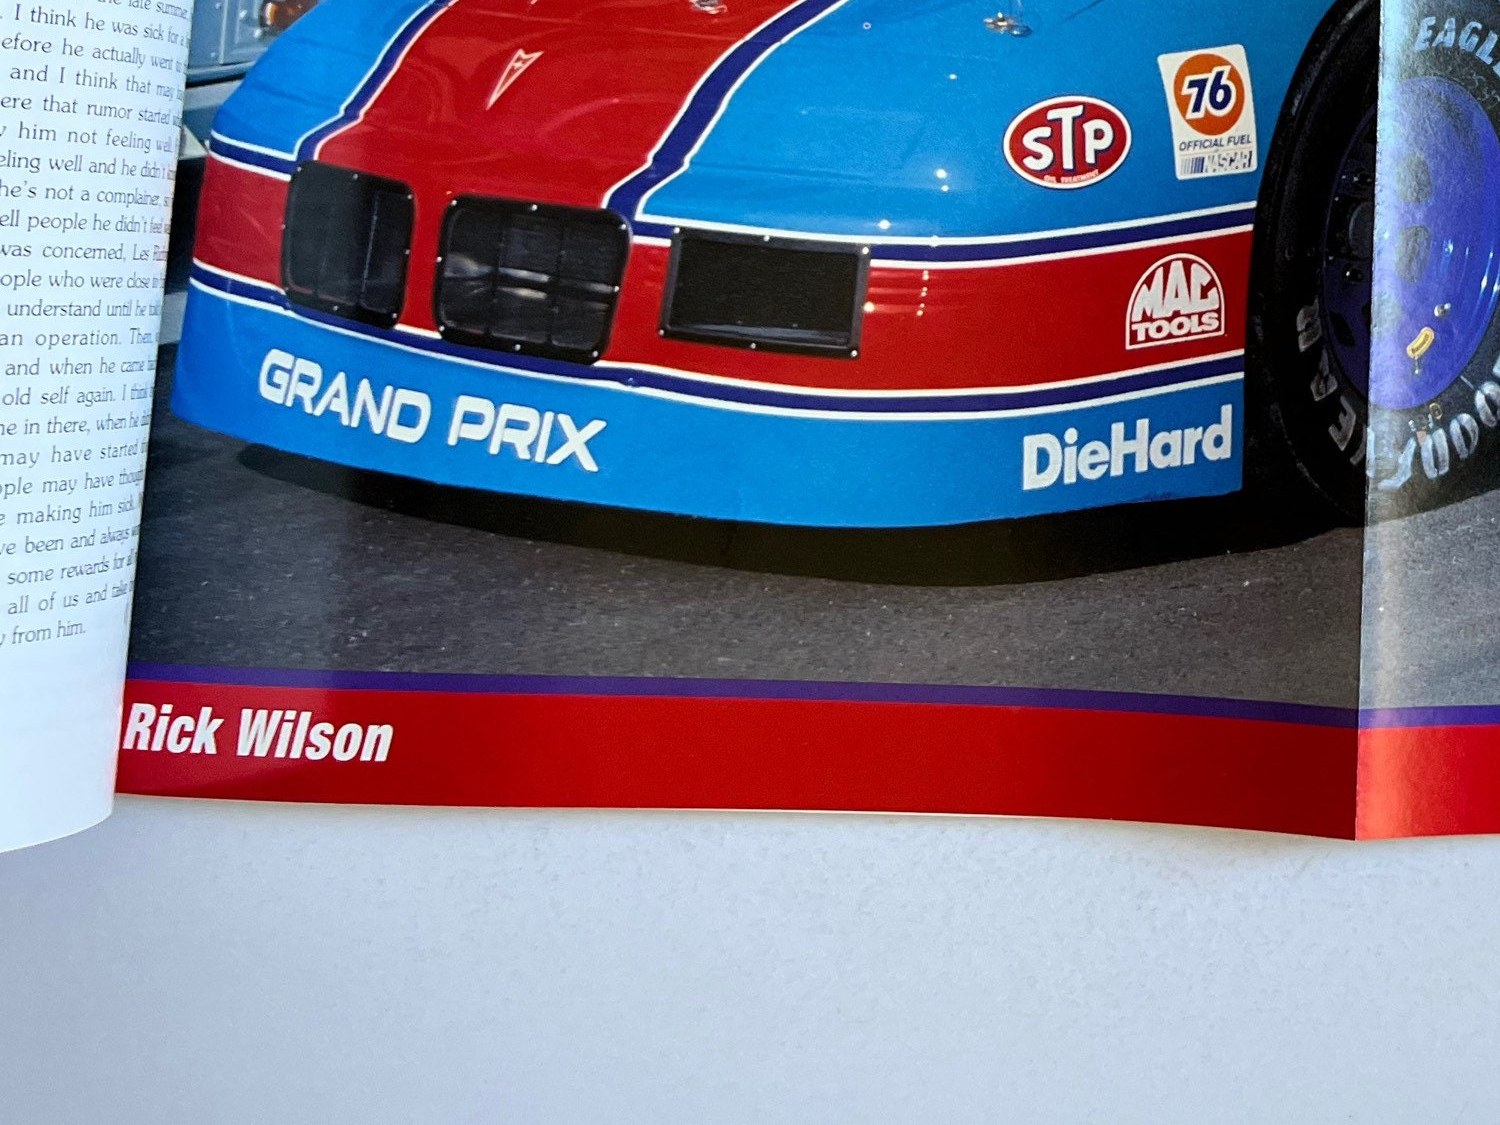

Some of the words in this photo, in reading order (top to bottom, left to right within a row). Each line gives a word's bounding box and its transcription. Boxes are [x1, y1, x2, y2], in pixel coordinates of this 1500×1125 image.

[15, 3, 22, 21] I
[30, 5, 77, 28] think
[85, 11, 105, 32] he
[112, 20, 139, 37] was
[143, 23, 165, 42] sick
[62, 38, 85, 57] he
[92, 47, 146, 69] actually
[150, 53, 174, 71] went
[10, 64, 48, 82] and
[59, 66, 66, 84] I
[75, 69, 118, 90] think
[126, 76, 152, 94] that
[1184, 67, 1234, 118] 76
[43, 94, 78, 114] that
[87, 103, 133, 120] rumor
[138, 108, 171, 126] started
[18, 120, 57, 142] him
[67, 129, 98, 145] not
[105, 128, 152, 154] feeling
[1021, 104, 1114, 171] STP
[1179, 137, 1225, 153] OFFICIAL
[1226, 133, 1253, 146] FUEL
[49, 154, 83, 173] well
[88, 157, 117, 175] and
[121, 158, 137, 177] he
[45, 185, 75, 201] not
[80, 190, 91, 202] a
[27, 212, 88, 234] people
[92, 213, 112, 231] he
[115, 214, 148, 234] didn't
[42, 242, 127, 263] concerned,
[132, 243, 150, 262] Les
[50, 269, 85, 288] who
[90, 276, 123, 289] were
[1131, 259, 1220, 323] MAC
[7, 298, 101, 317] understand
[106, 299, 132, 317] until
[35, 330, 122, 350] operation.
[1131, 311, 1220, 343] TOOLS
[5, 357, 40, 376] and
[50, 357, 93, 375] when
[100, 356, 117, 374] he
[2, 386, 32, 406] old
[40, 385, 70, 405] self
[76, 387, 116, 408] again.
[259, 347, 432, 445] GRAND
[447, 393, 608, 474] PRIX
[23, 419, 41, 436] in
[47, 416, 91, 436] there,
[96, 412, 127, 431] when
[51, 444, 92, 464] have
[100, 438, 139, 460] started
[1022, 403, 1233, 491] DieHard
[42, 477, 78, 496] may
[84, 472, 115, 491] have
[16, 504, 82, 525] making
[88, 500, 113, 519] him
[24, 535, 65, 554] been
[70, 528, 96, 549] and
[7, 567, 55, 586] some
[60, 555, 110, 580] rewards
[7, 594, 30, 616] all
[38, 591, 57, 612] of
[63, 594, 79, 609] us
[85, 583, 108, 605] and
[11, 625, 53, 645] from
[56, 619, 87, 639] him.
[122, 702, 225, 755] Rick
[236, 707, 395, 763] Wilson
